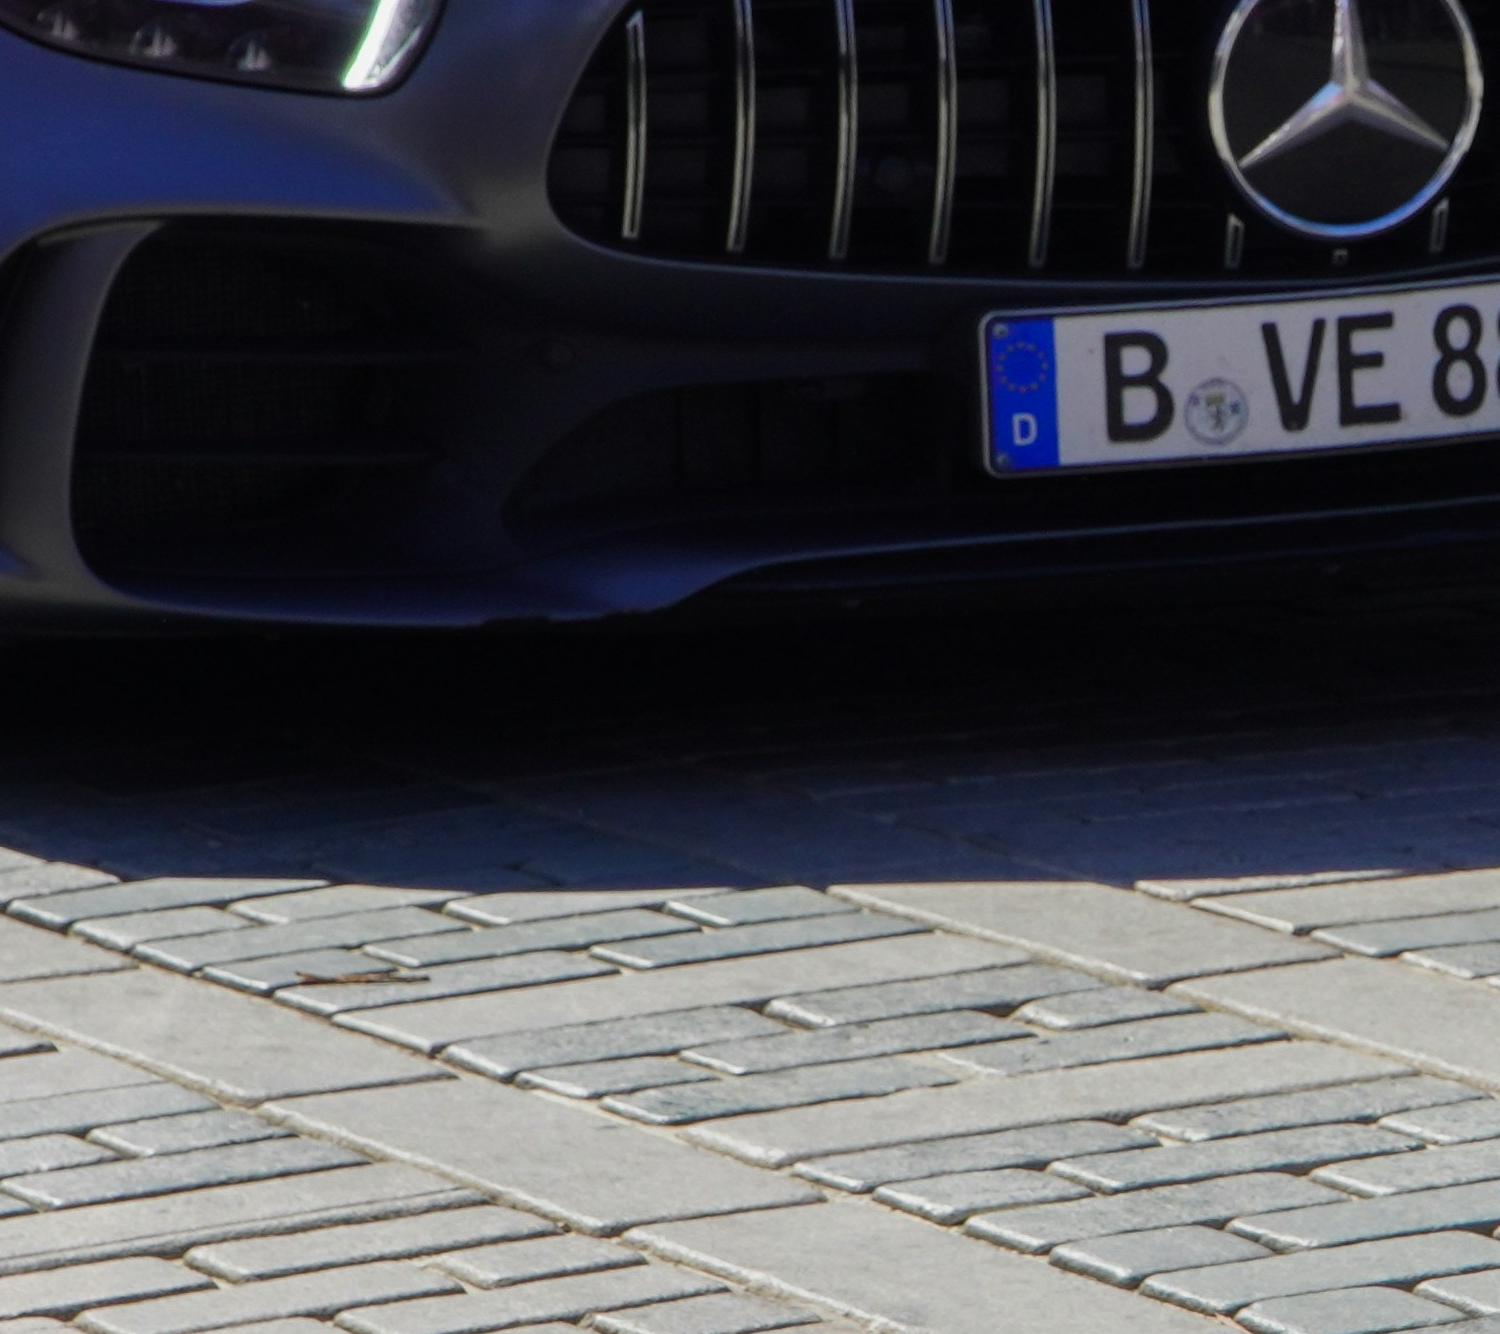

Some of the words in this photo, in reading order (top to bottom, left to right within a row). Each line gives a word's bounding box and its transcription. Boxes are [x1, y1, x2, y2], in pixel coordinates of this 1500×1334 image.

[1103, 330, 1176, 443] B
[1260, 311, 1403, 432] VE
[1011, 412, 1038, 447] D
